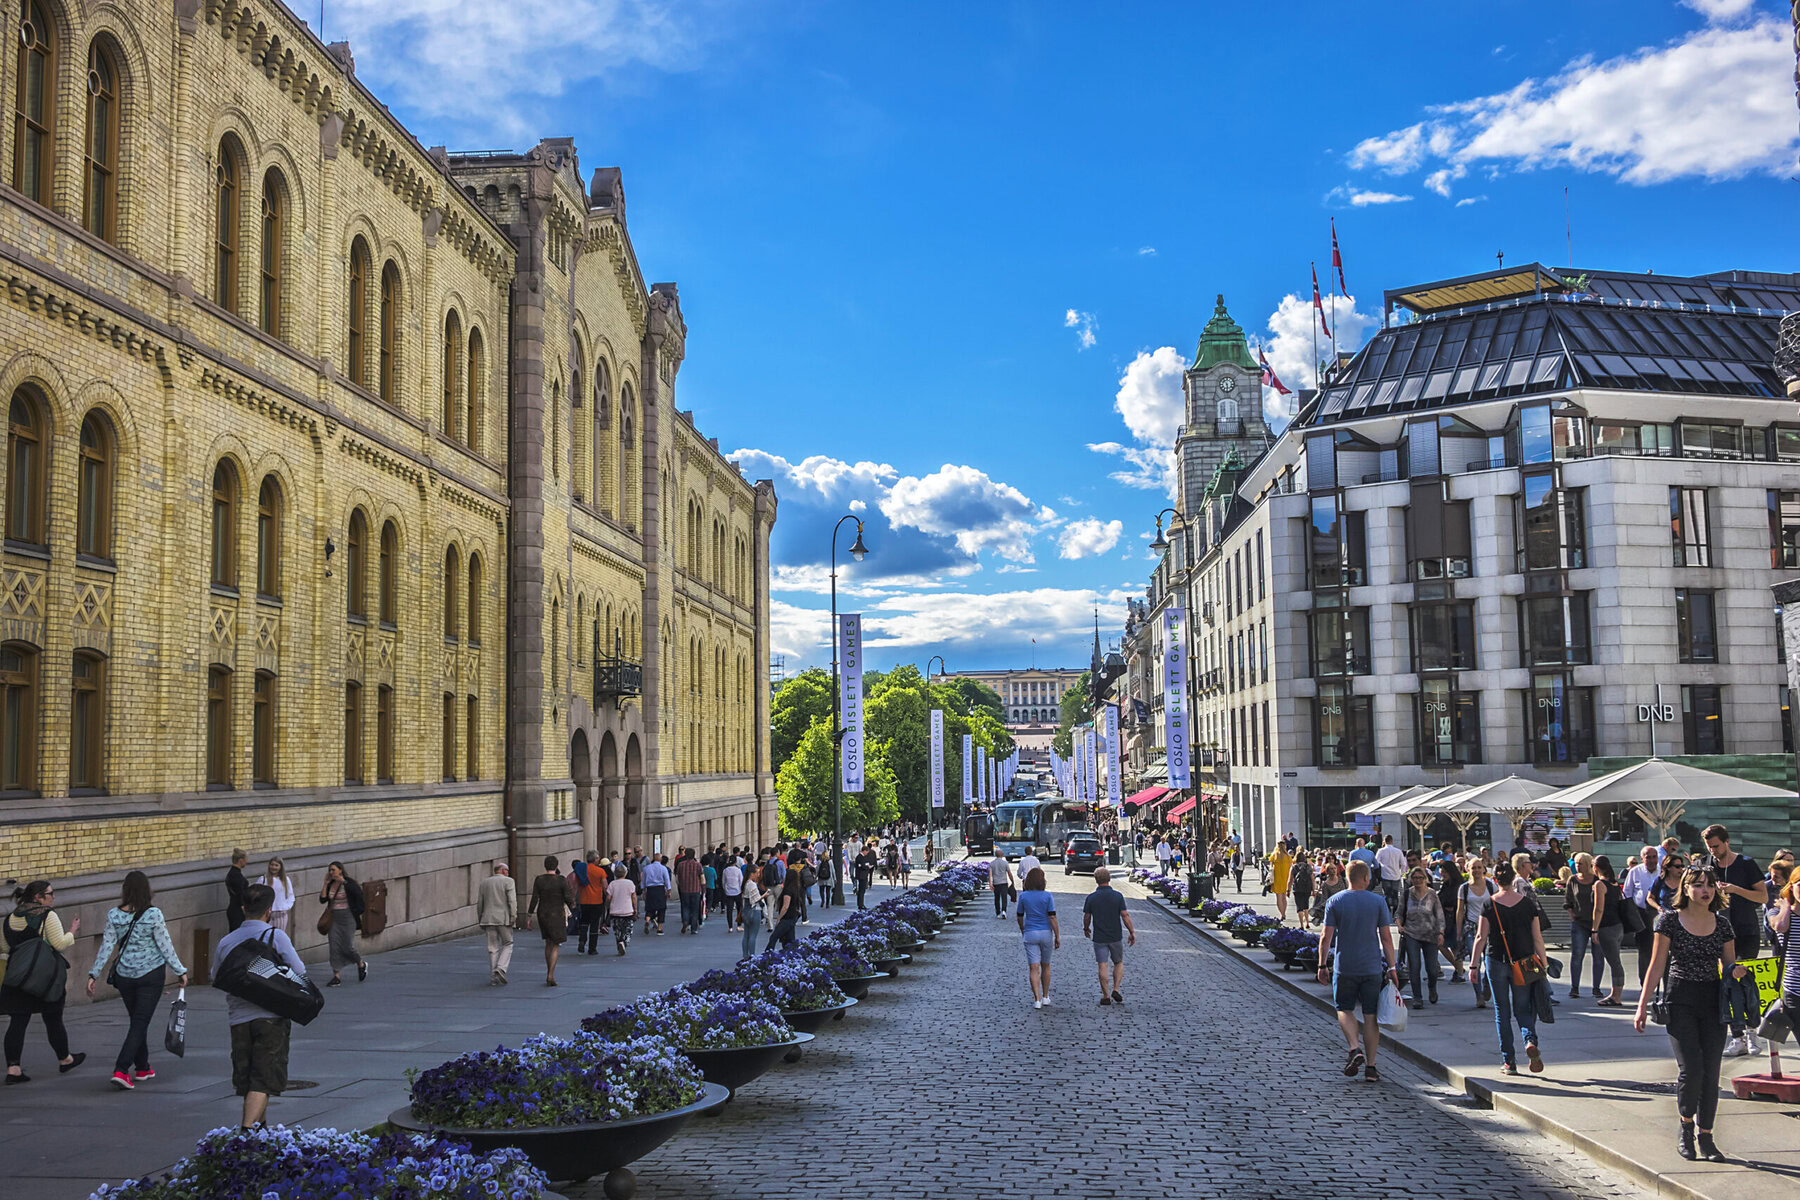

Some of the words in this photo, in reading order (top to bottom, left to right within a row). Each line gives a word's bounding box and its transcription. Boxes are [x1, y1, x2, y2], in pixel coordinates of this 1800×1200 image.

[846, 620, 856, 668] GAMES
[1169, 615, 1180, 662] GAMES
[847, 675, 857, 733] BISLETT
[1171, 670, 1182, 728] BISLETT
[1322, 706, 1341, 715] DNB
[1426, 703, 1447, 712] DNB
[1538, 698, 1560, 707] DNB
[1637, 704, 1674, 721] DNB
[848, 738, 857, 770] OSLO
[1173, 734, 1183, 767] OSLO
